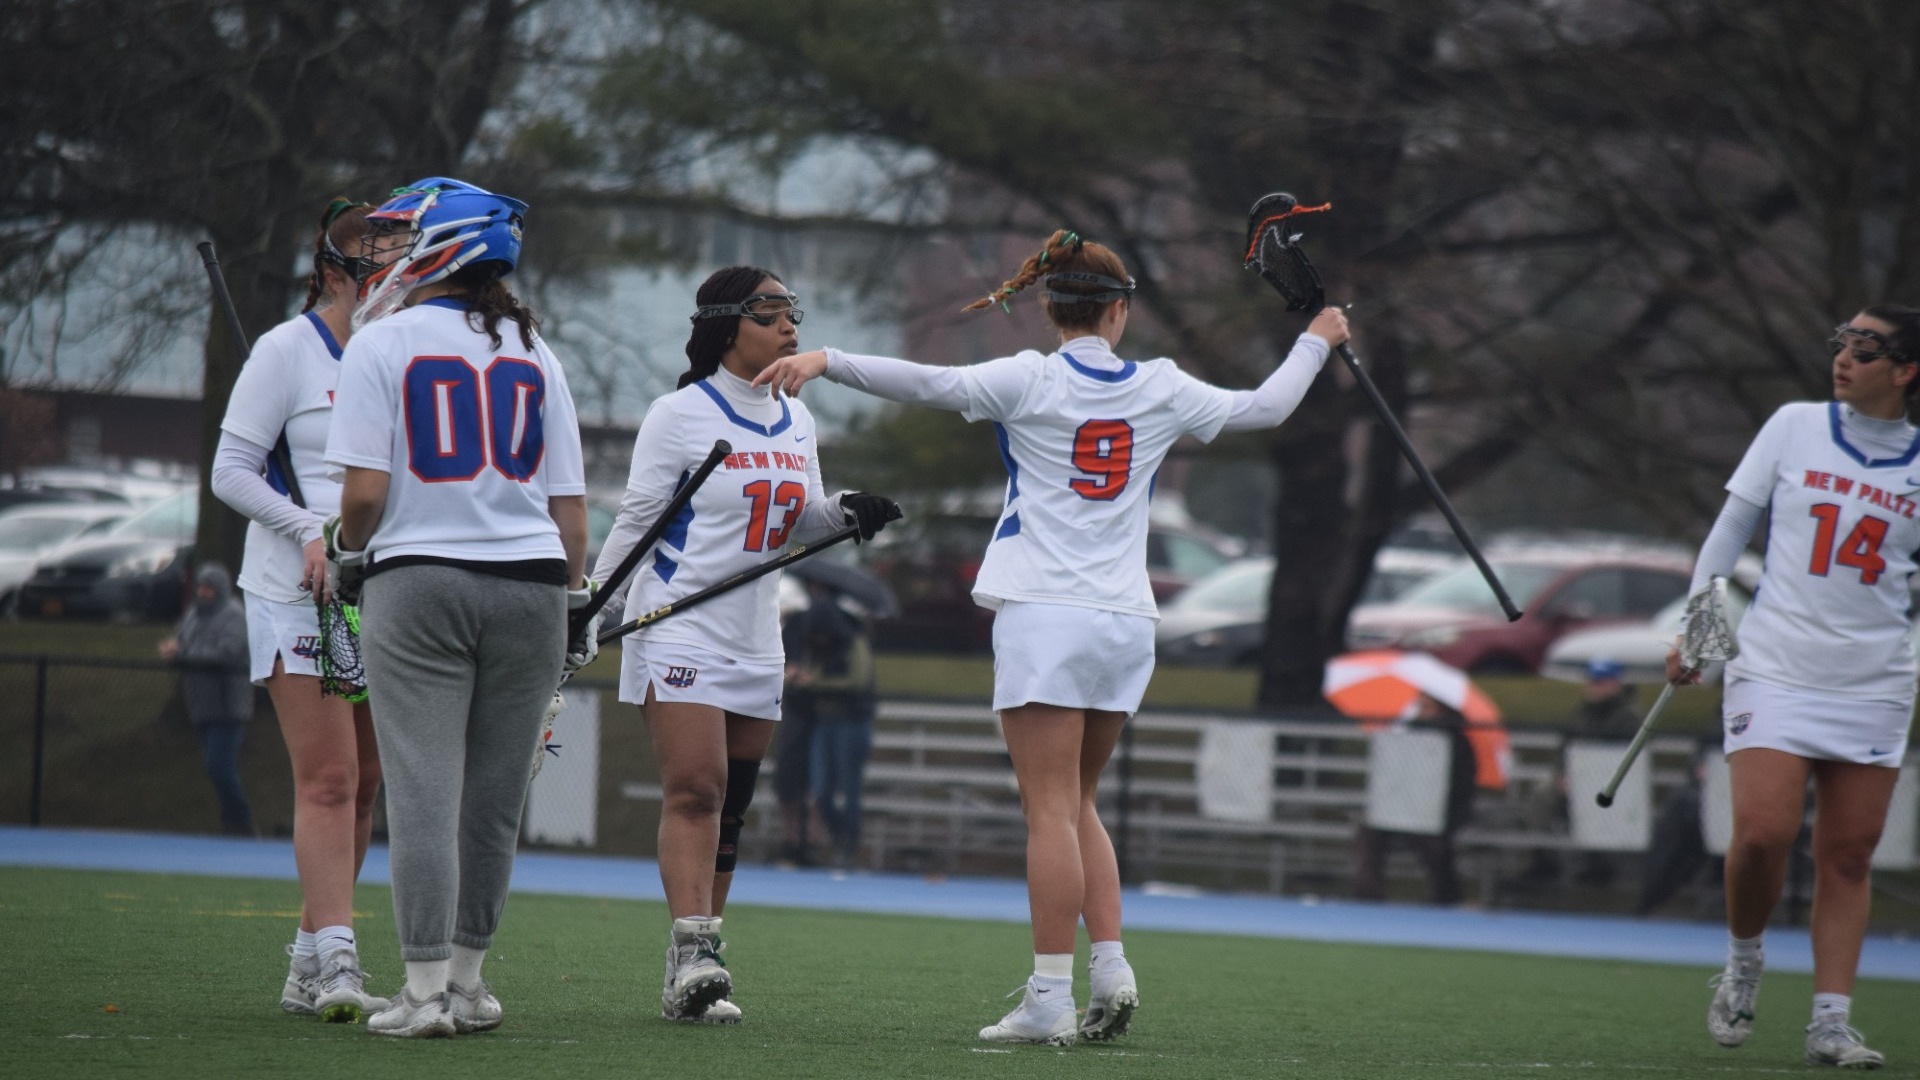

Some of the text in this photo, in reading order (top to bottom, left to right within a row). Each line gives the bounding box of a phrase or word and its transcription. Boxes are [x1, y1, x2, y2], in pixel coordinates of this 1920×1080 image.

[403, 355, 545, 483] 00
[724, 451, 807, 472] NEW PALT
[1069, 418, 1134, 502] 9
[1803, 470, 1917, 519] NEW PALTZ
[743, 479, 806, 553] 13
[1808, 502, 1890, 586] 14
[670, 667, 697, 682] NP
